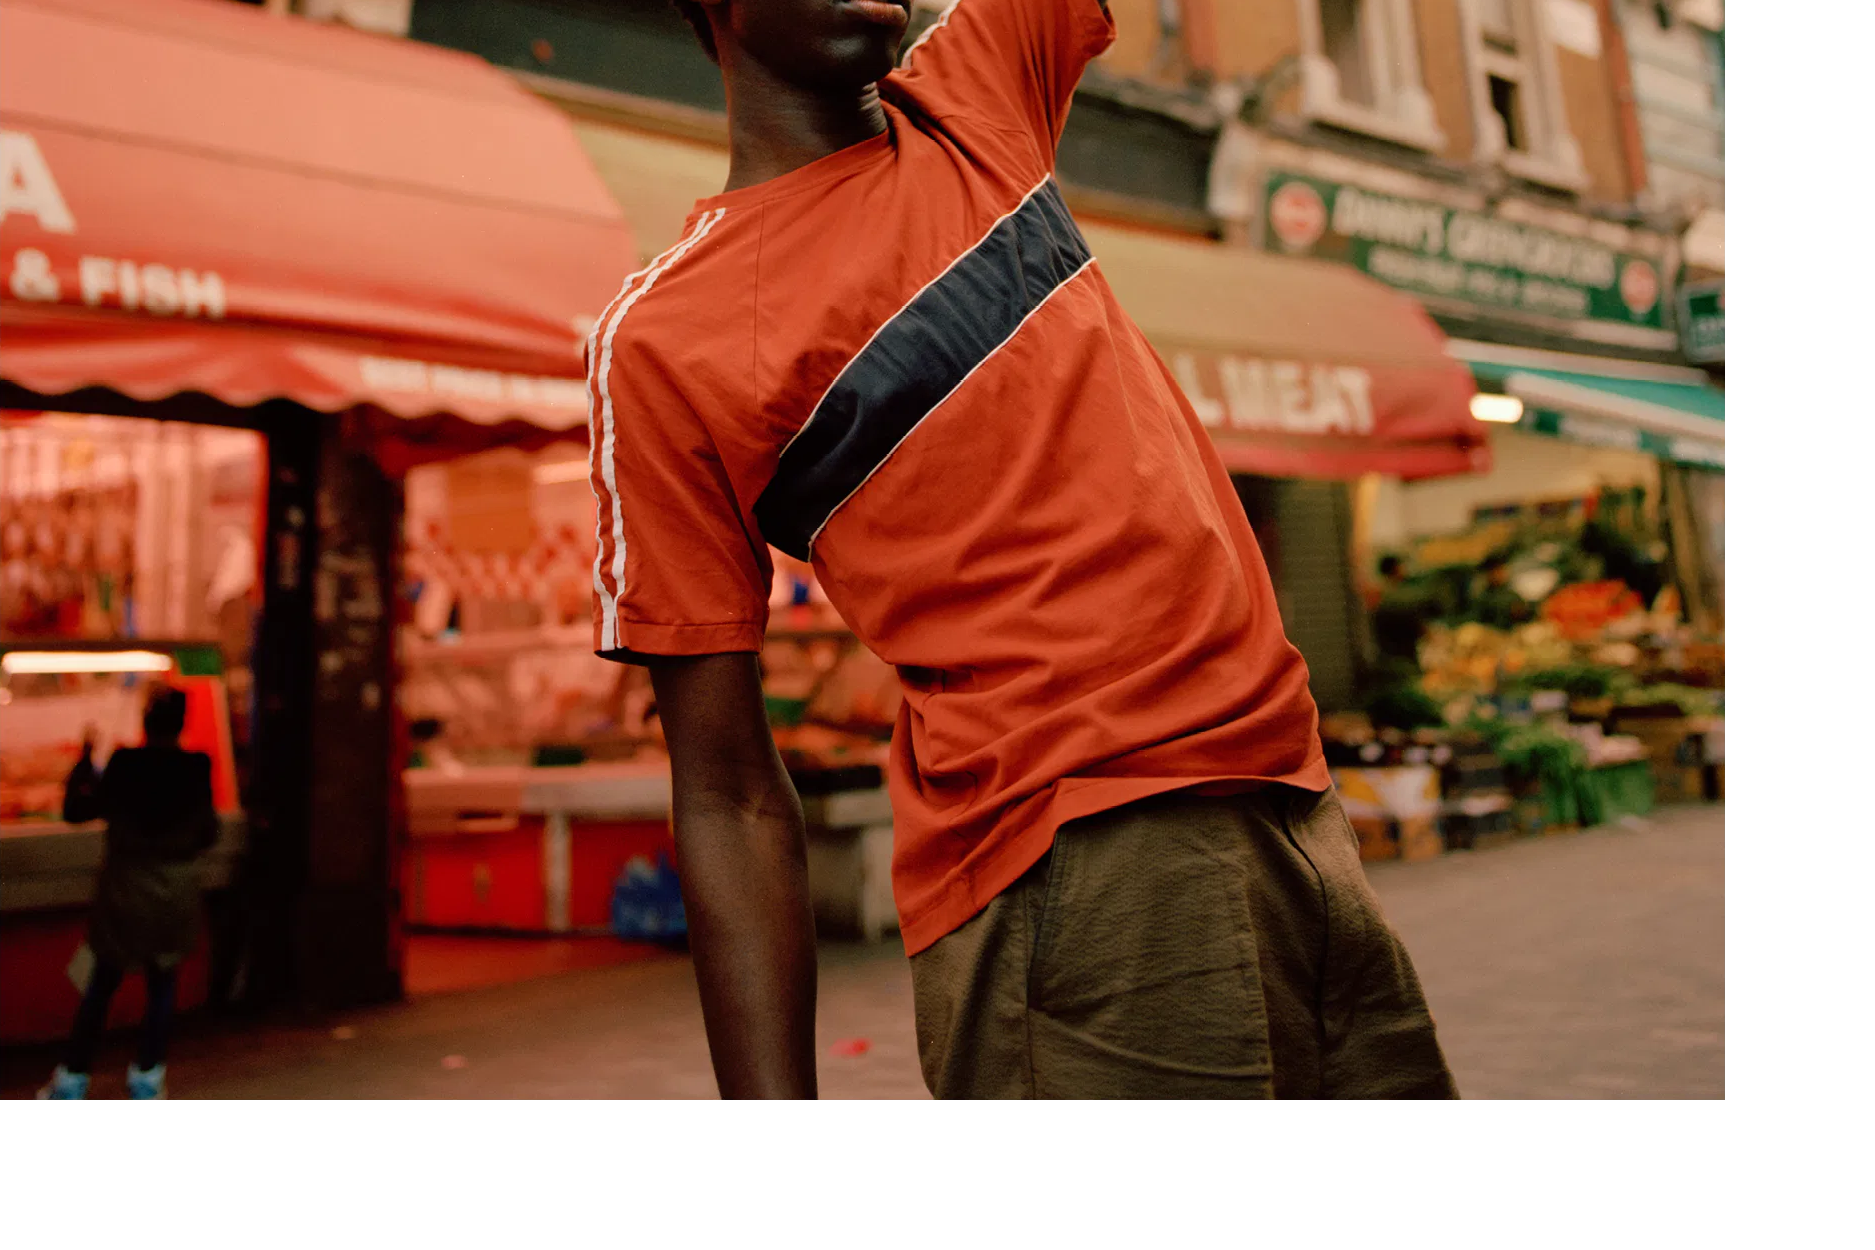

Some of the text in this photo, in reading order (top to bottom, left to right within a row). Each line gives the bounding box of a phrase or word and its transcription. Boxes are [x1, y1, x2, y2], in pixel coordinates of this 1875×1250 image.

[9, 247, 226, 318] & FISH
[1220, 354, 1373, 435] MEAT
